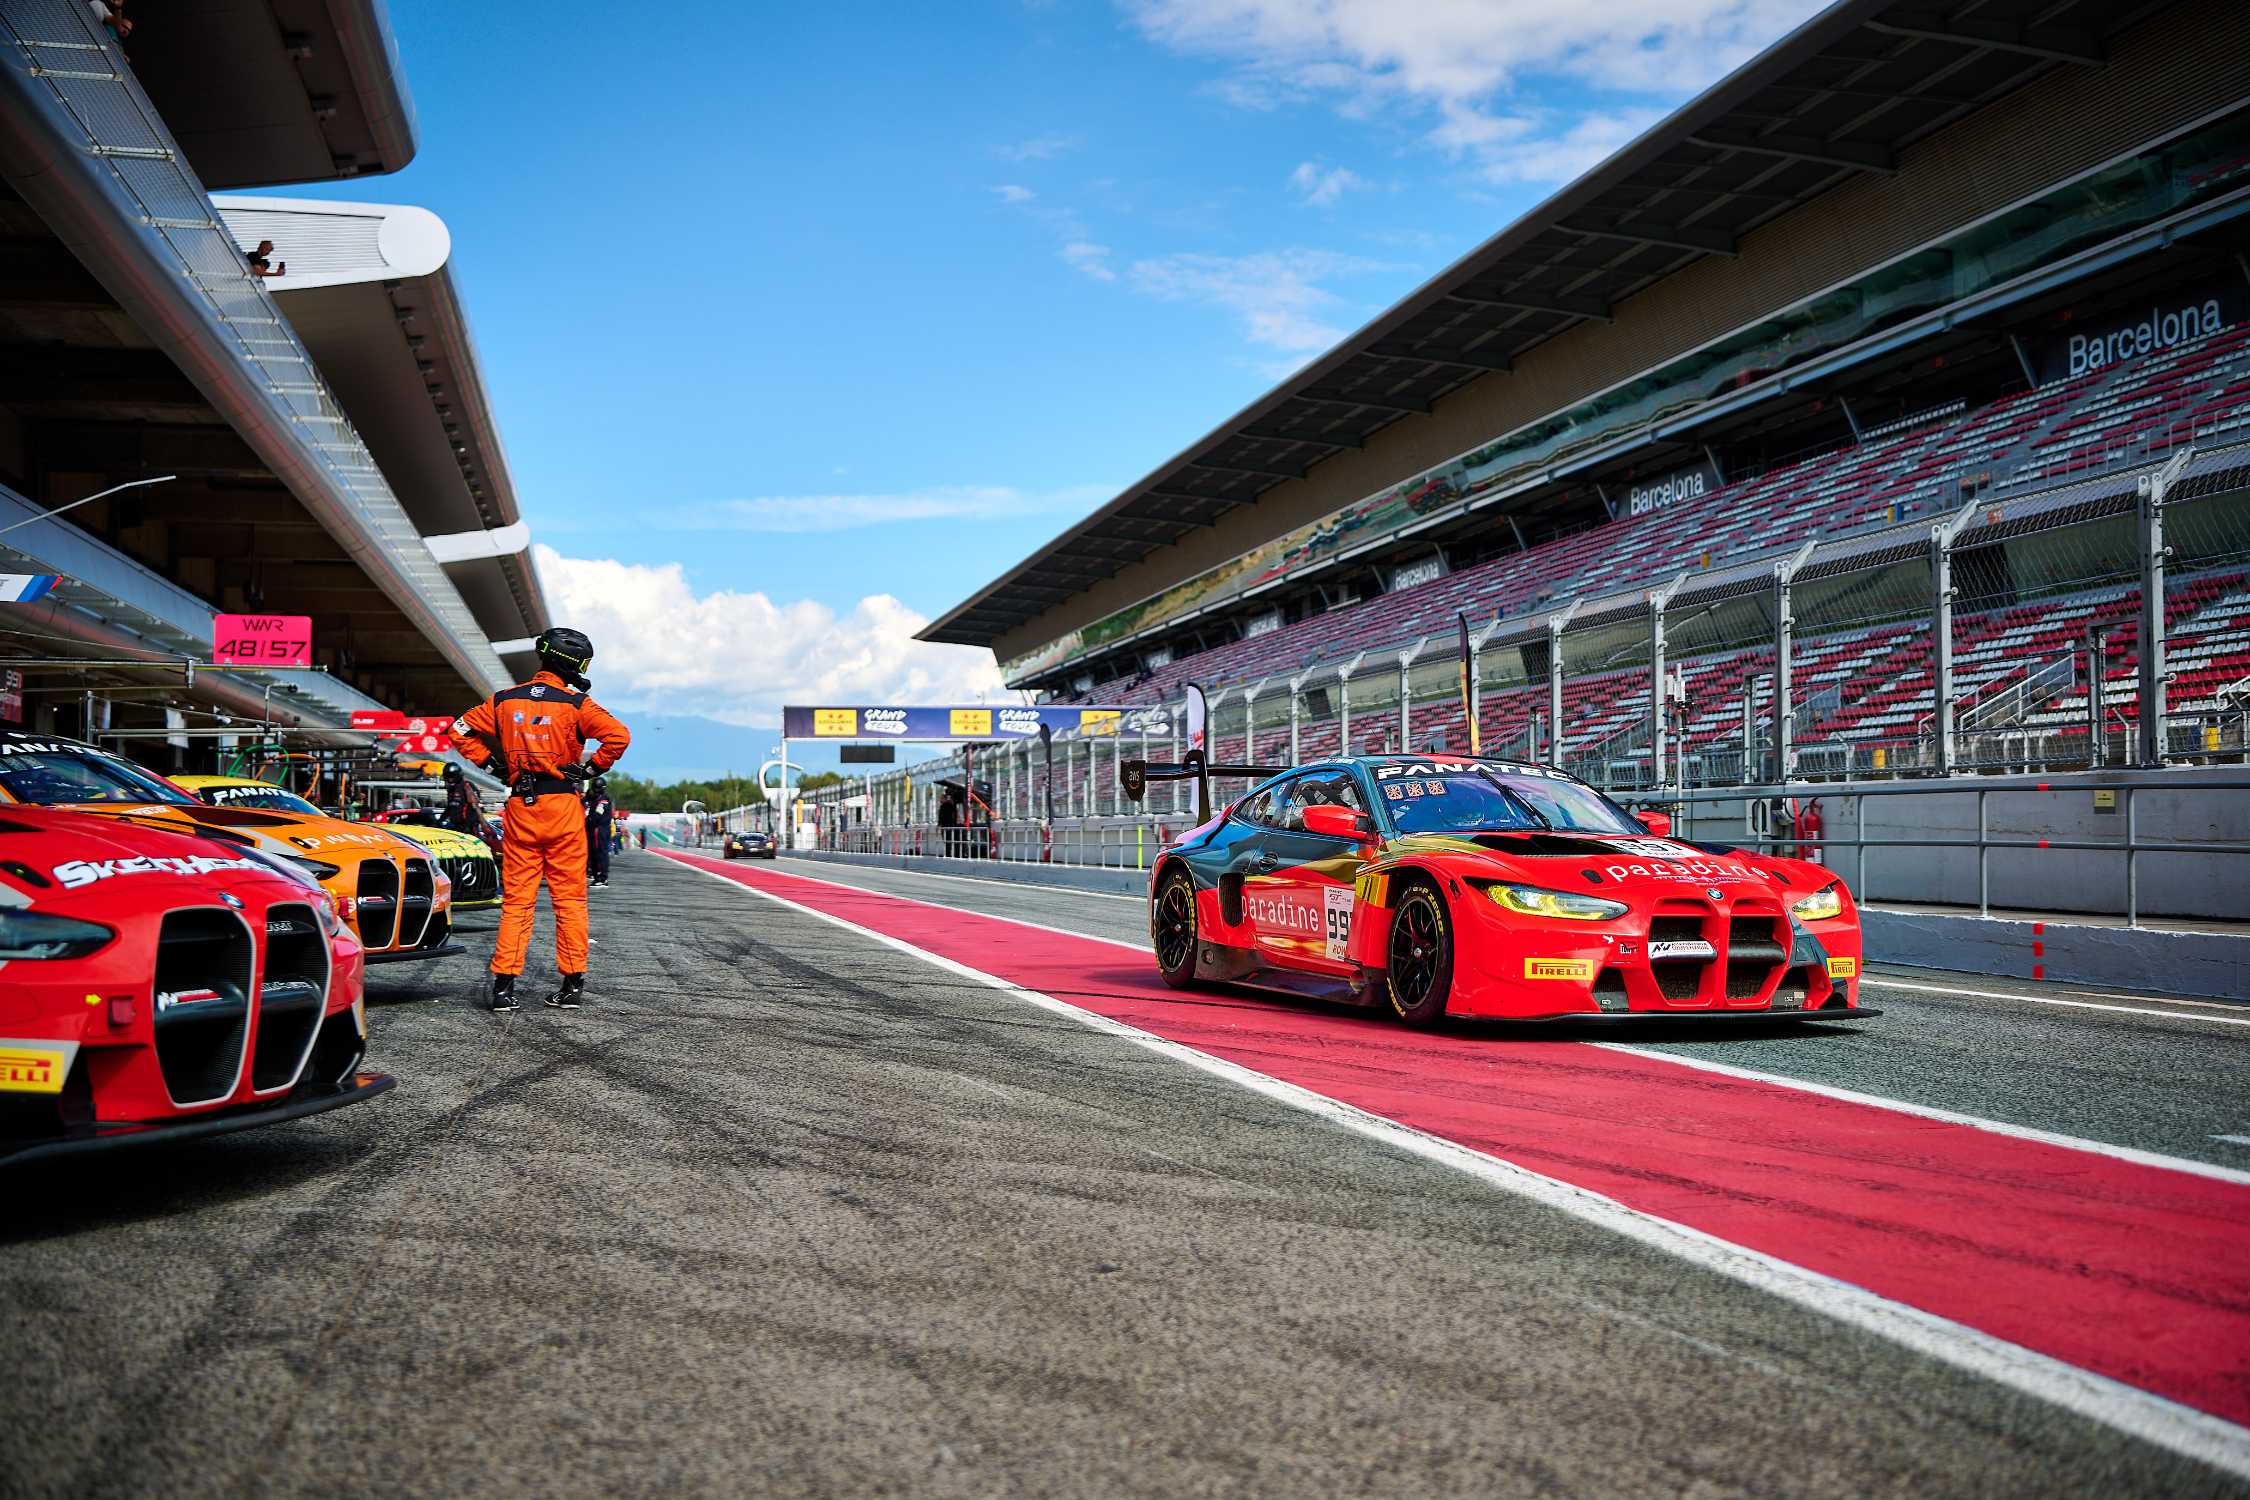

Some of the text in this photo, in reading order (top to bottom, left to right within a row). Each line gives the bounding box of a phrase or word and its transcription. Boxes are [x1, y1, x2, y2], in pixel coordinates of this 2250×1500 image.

[2069, 299, 2221, 375] Barcelona
[1630, 472, 1704, 515] Barcelona
[864, 708, 908, 721] GRAND
[998, 709, 1040, 721] GRAND
[1377, 763, 1575, 782] FANATEC
[1241, 895, 1319, 932] paradine
[1531, 962, 1587, 976] PIRELLI
[1830, 961, 1853, 974] PIRELLI
